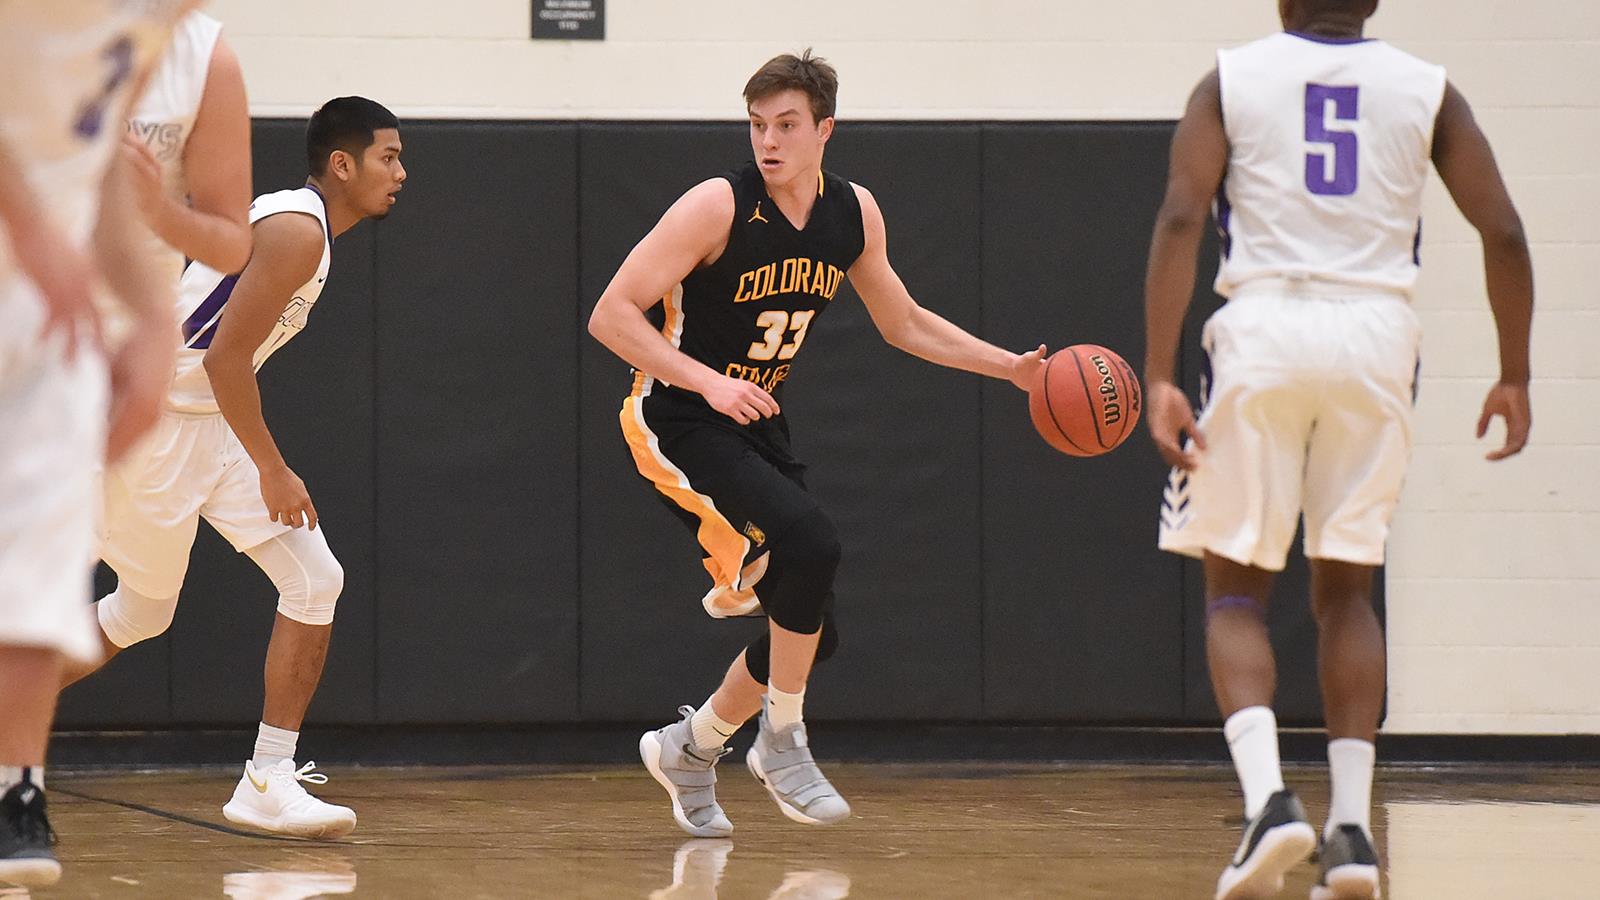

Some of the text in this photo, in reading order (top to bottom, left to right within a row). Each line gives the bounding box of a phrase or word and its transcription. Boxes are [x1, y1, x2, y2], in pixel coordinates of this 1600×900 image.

[1304, 83, 1359, 196] 5
[746, 310, 816, 361] 33
[1089, 354, 1121, 427] Wilson
